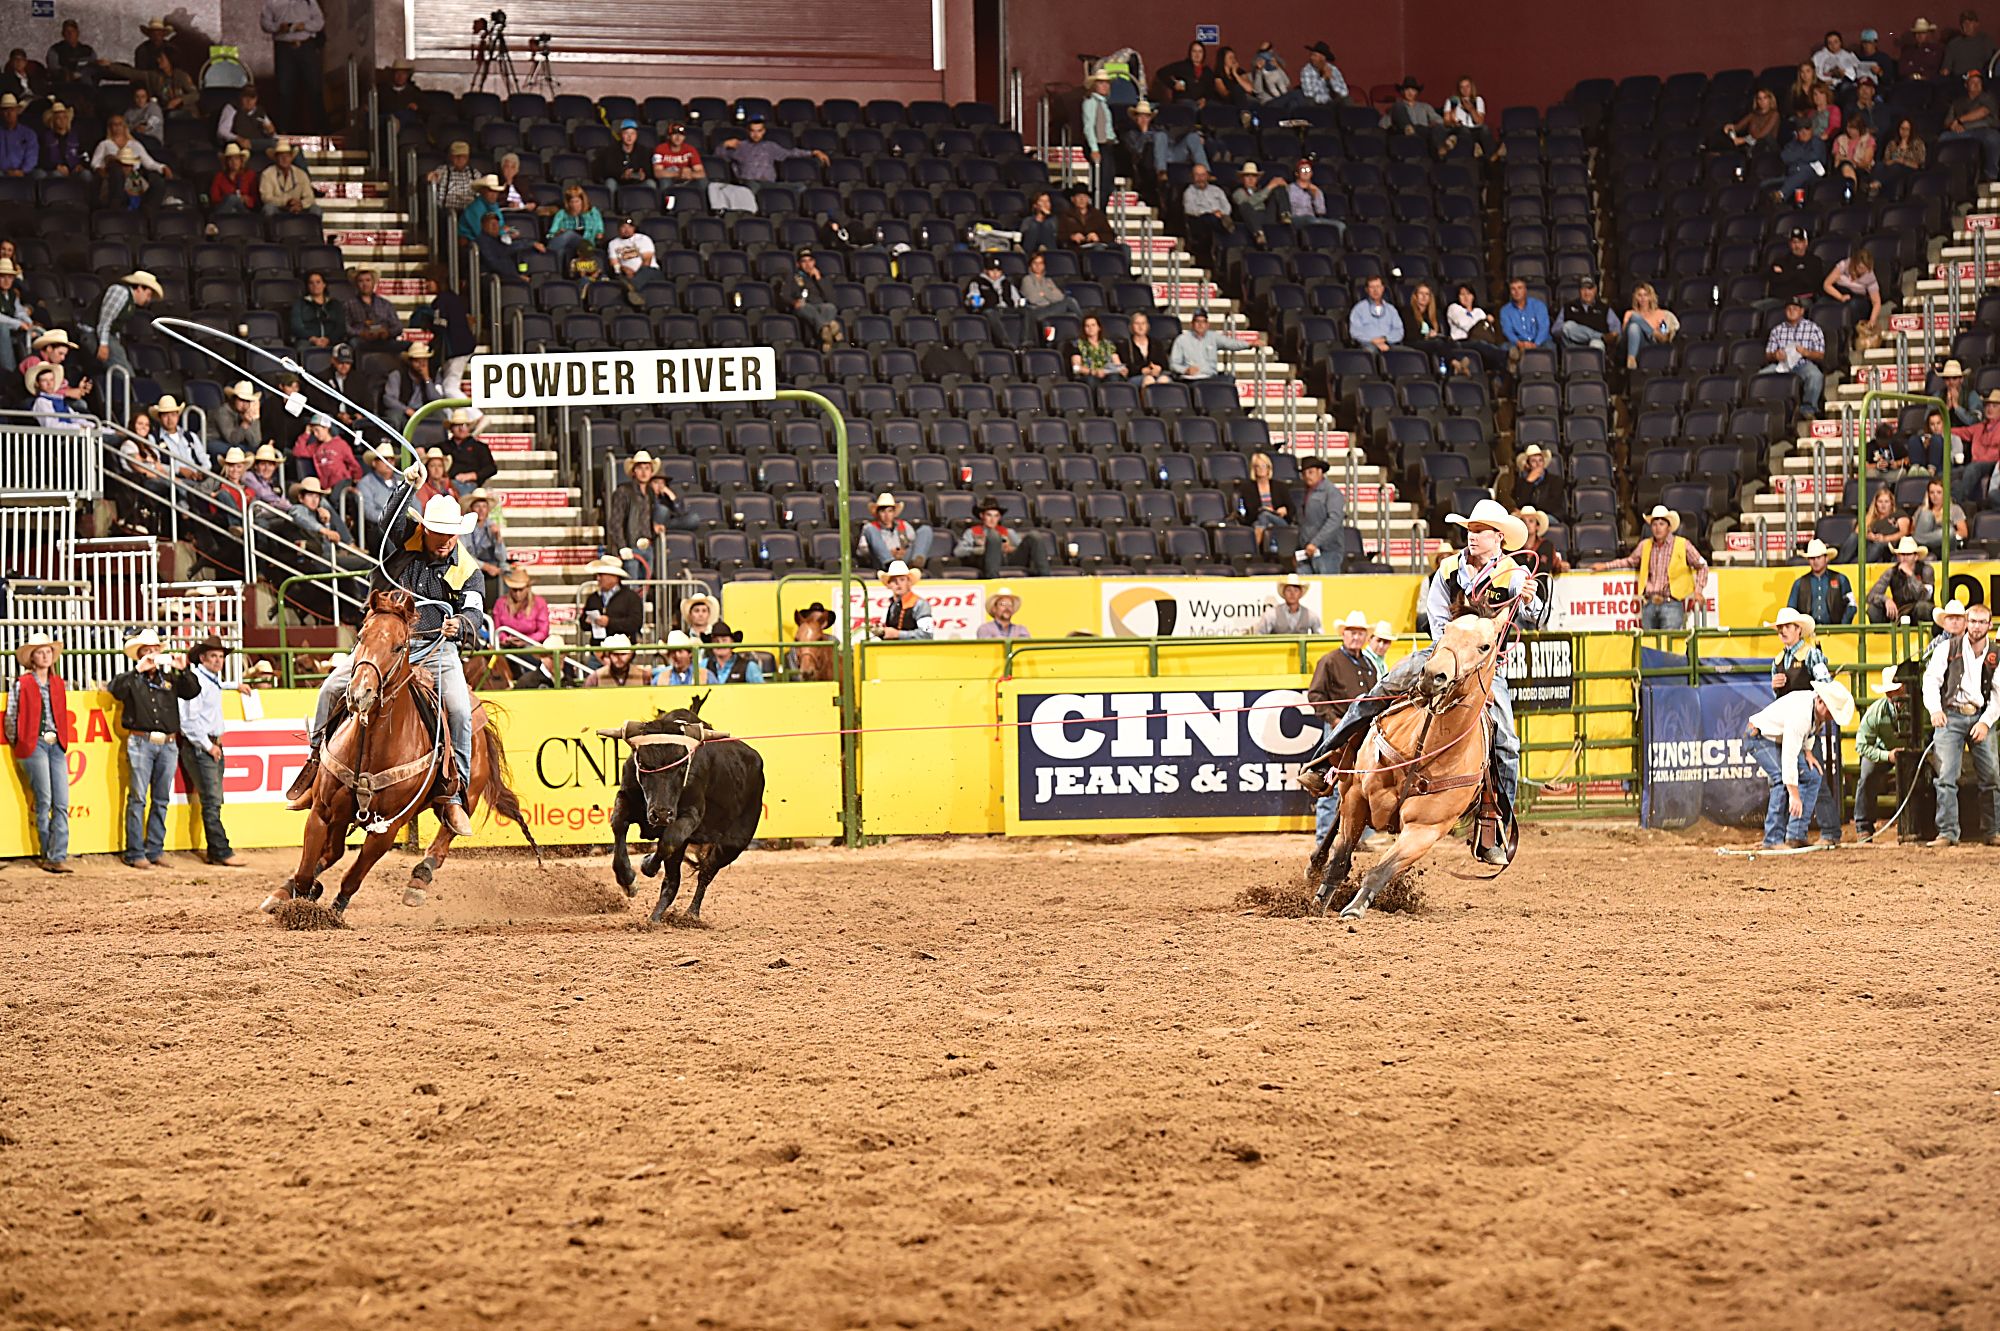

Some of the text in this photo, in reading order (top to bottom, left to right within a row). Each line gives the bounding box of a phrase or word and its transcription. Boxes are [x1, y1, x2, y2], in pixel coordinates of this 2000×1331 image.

[483, 356, 762, 399] POWDER RIVER
[1530, 640, 1572, 679] RIVER
[1538, 685, 1570, 701] EQUIPMENT
[1031, 689, 1323, 760] CINC
[1035, 764, 1180, 804] JEANS
[1190, 763, 1228, 793] &
[1703, 766, 1753, 783] JEANS
